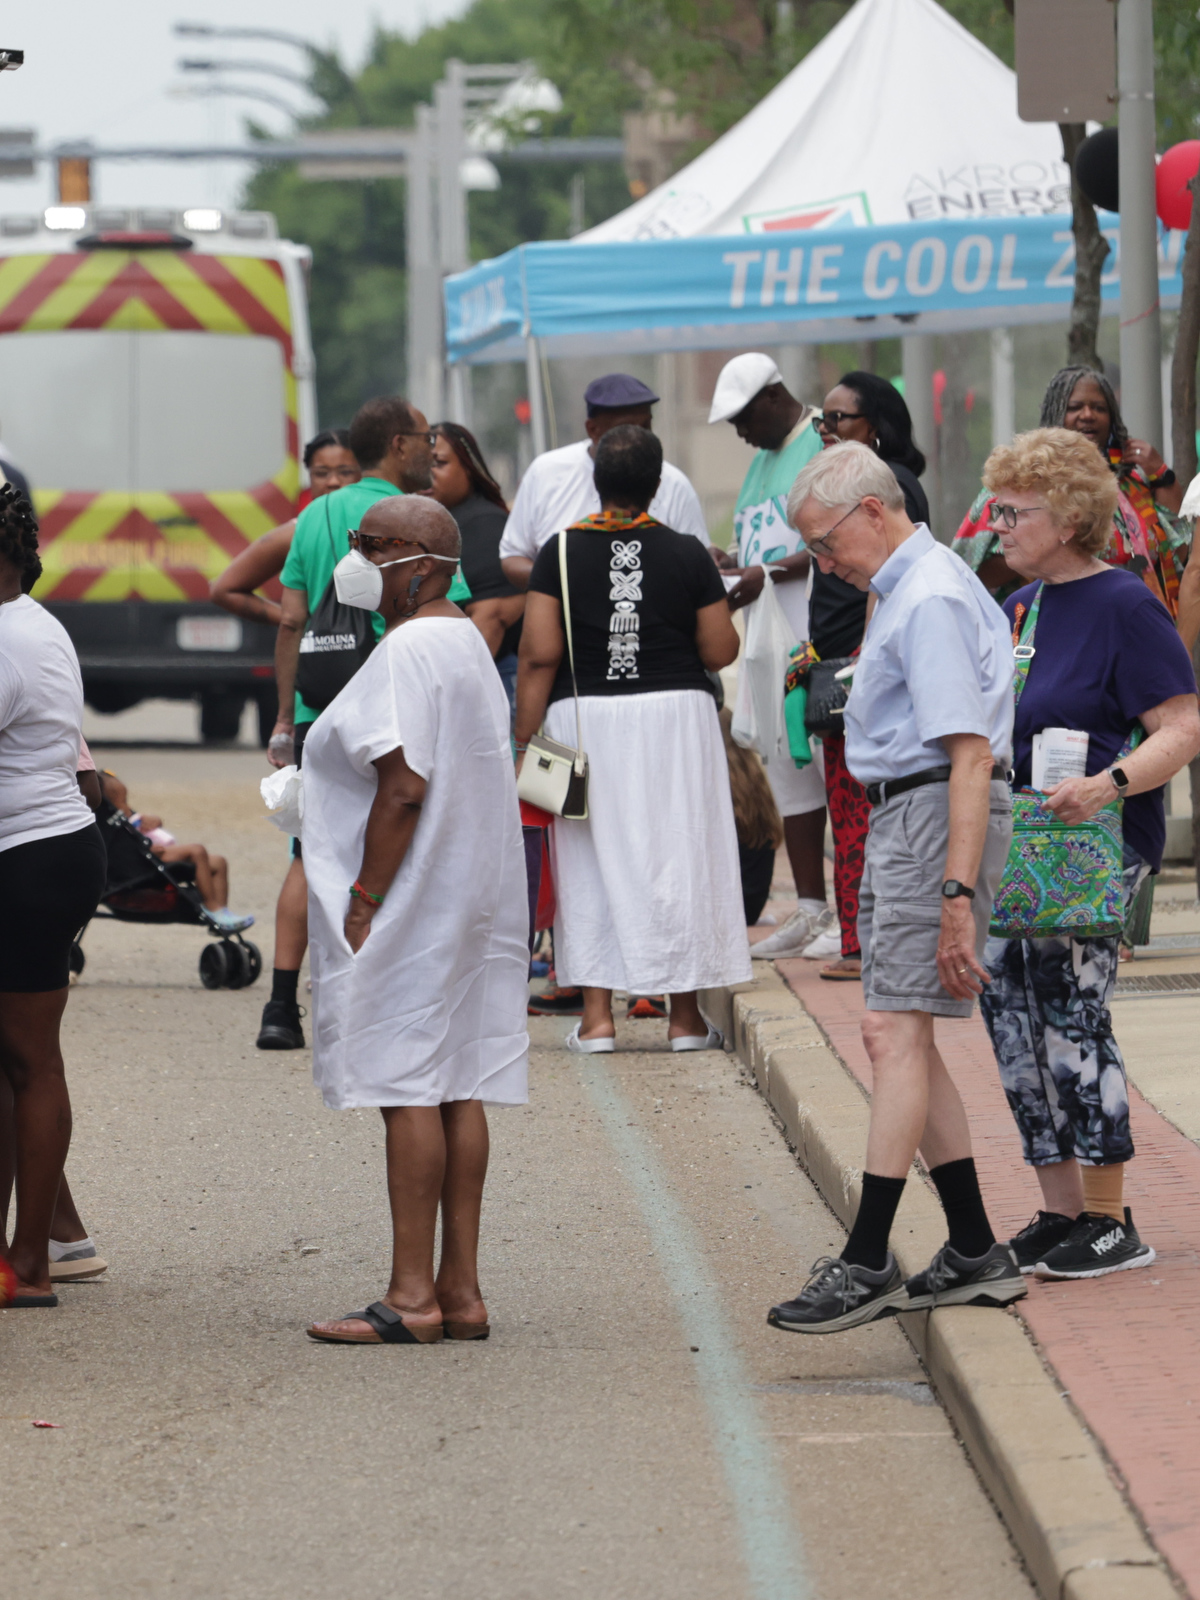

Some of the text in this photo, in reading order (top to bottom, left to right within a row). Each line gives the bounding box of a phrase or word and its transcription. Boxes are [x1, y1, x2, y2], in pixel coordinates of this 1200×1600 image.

[907, 184, 1072, 219] ENERG
[722, 229, 1183, 308] THE COOL ZN
[314, 634, 356, 645] MOLINA
[1090, 1226, 1125, 1255] HOKA
